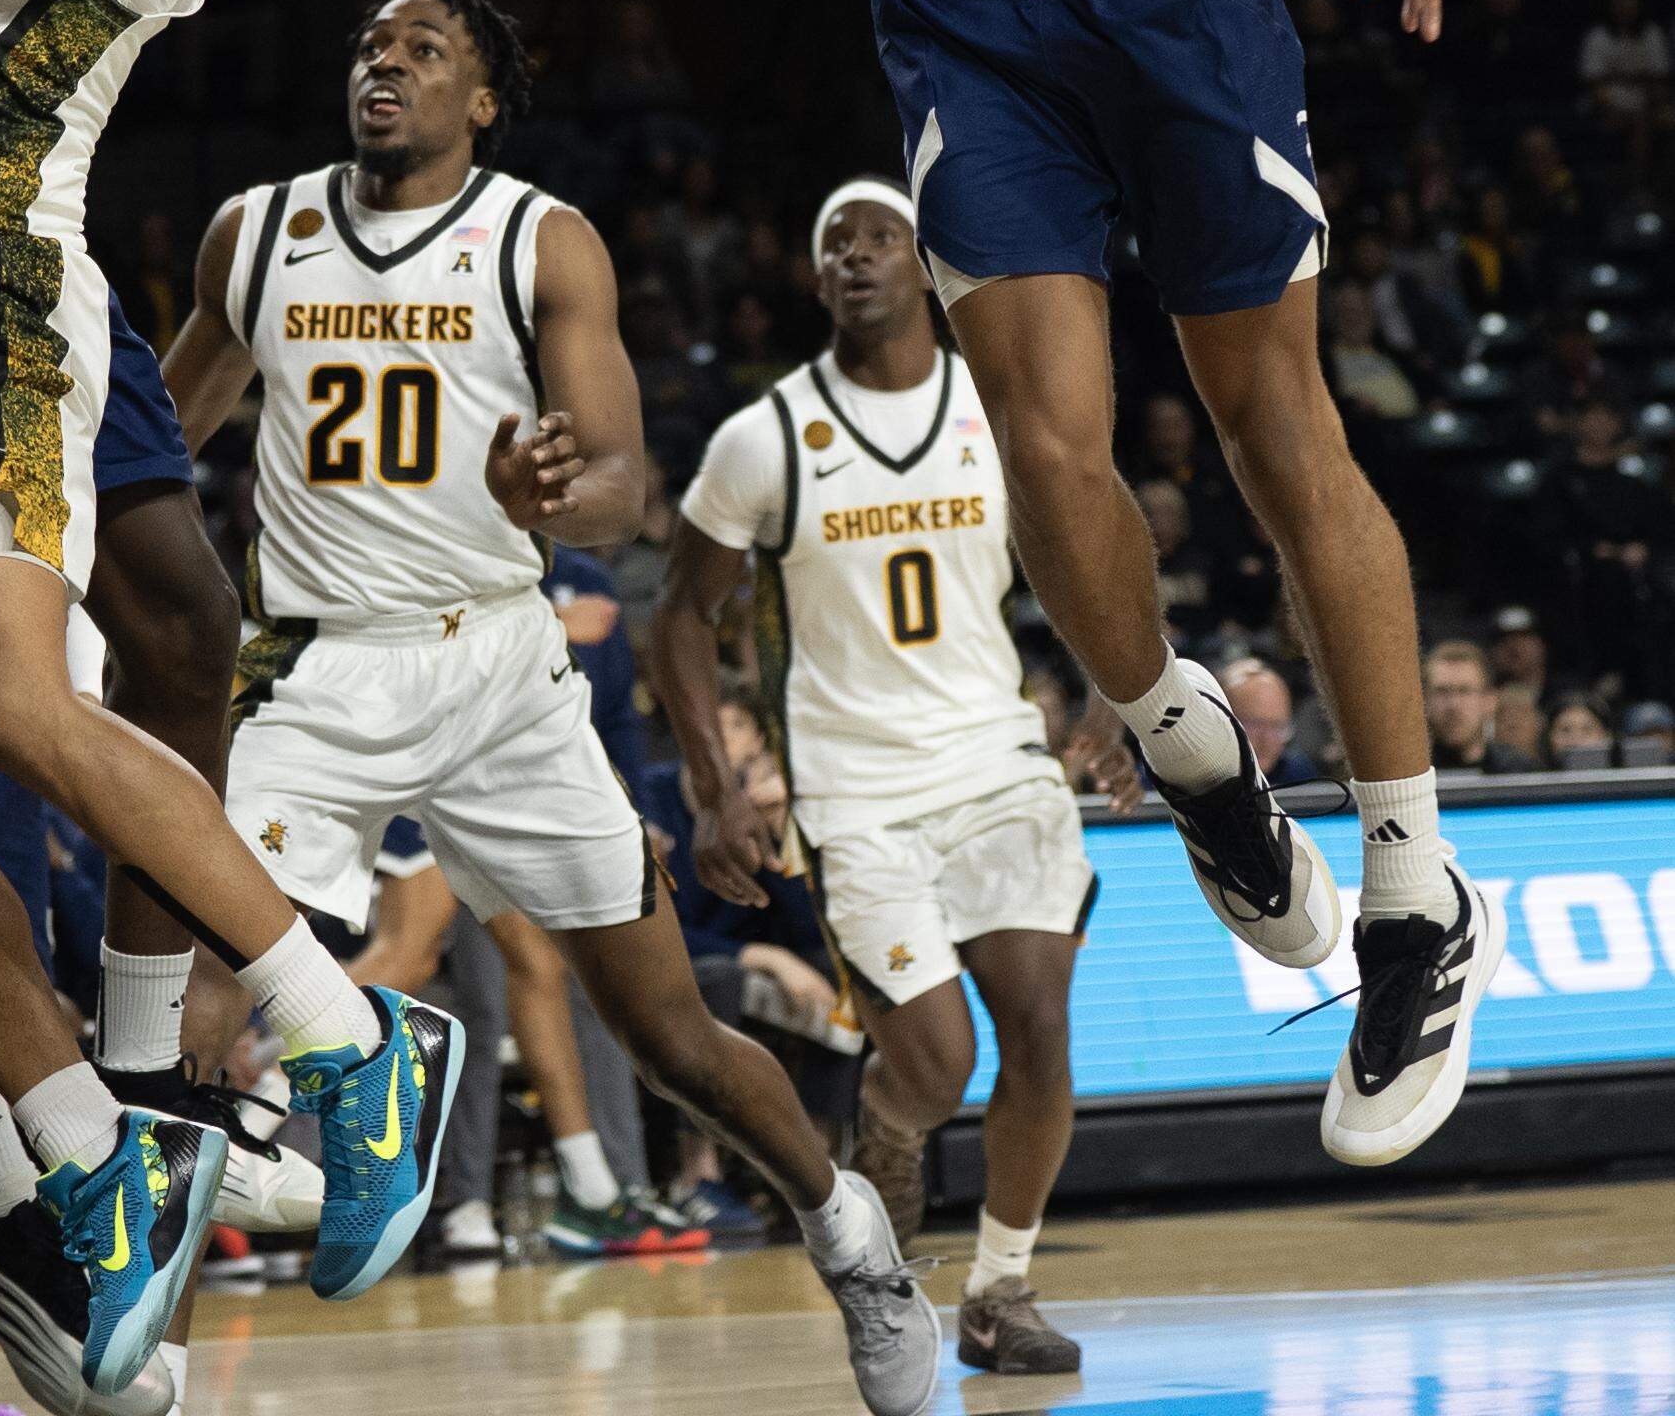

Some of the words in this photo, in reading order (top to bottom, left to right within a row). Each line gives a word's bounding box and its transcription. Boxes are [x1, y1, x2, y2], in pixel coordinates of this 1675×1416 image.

[284, 303, 474, 344] SHOCKERS
[306, 362, 441, 488] 20
[822, 496, 986, 545] SHOCKERS
[884, 548, 942, 649] 0
